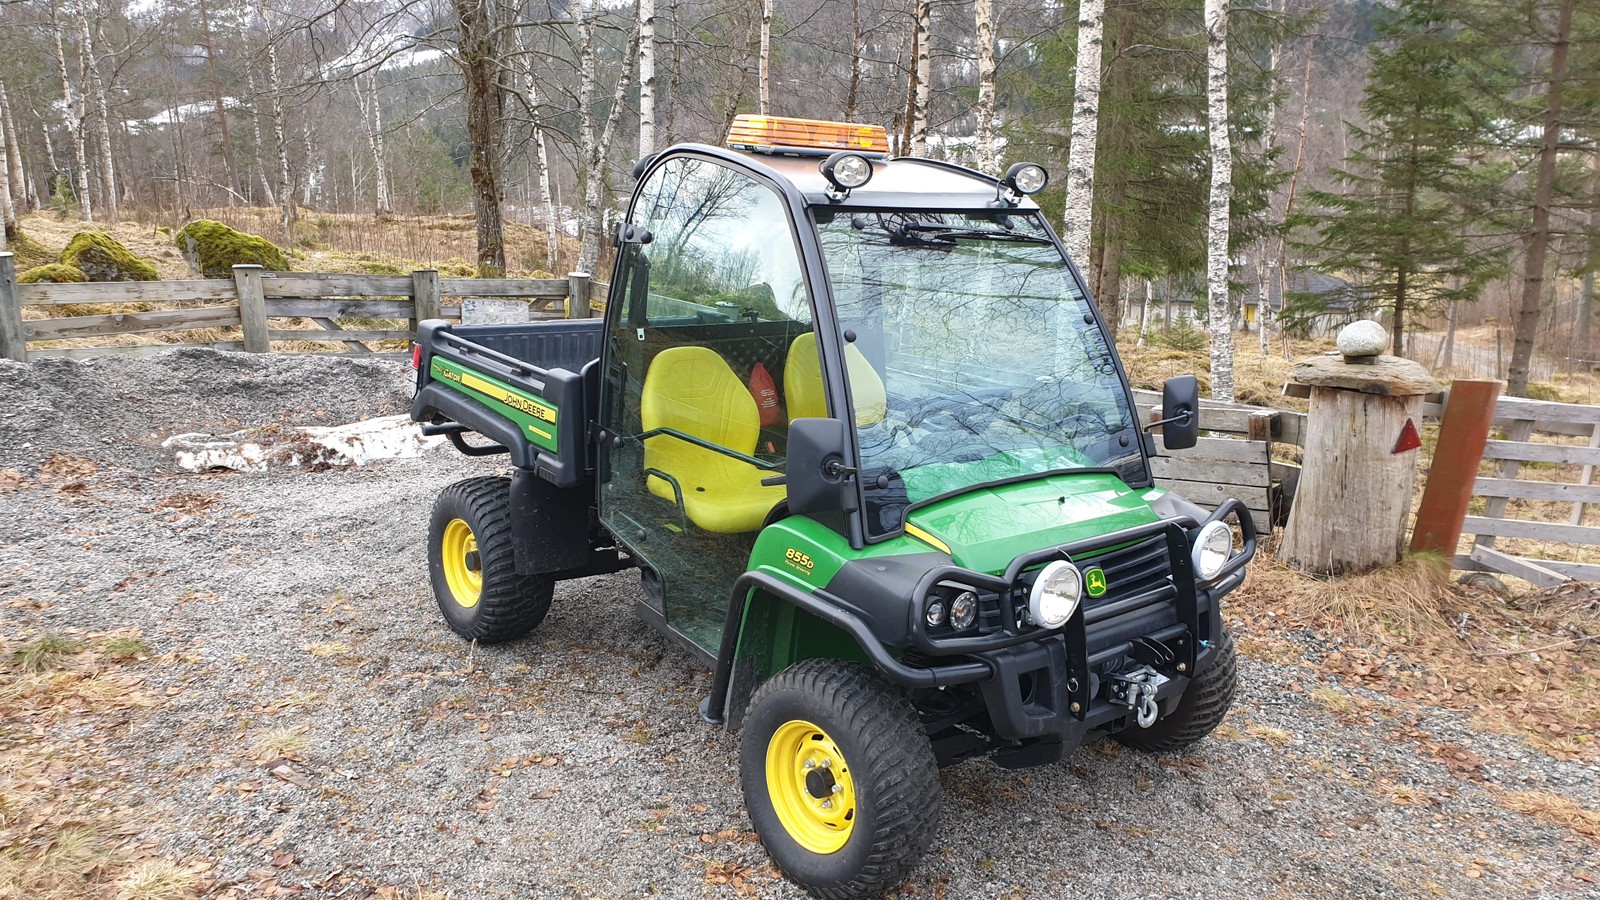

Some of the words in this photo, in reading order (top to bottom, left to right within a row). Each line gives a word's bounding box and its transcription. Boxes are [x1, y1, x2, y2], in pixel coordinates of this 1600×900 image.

[503, 392, 522, 411] JOHN
[522, 400, 546, 420] DEERE
[785, 547, 814, 569] 855D
